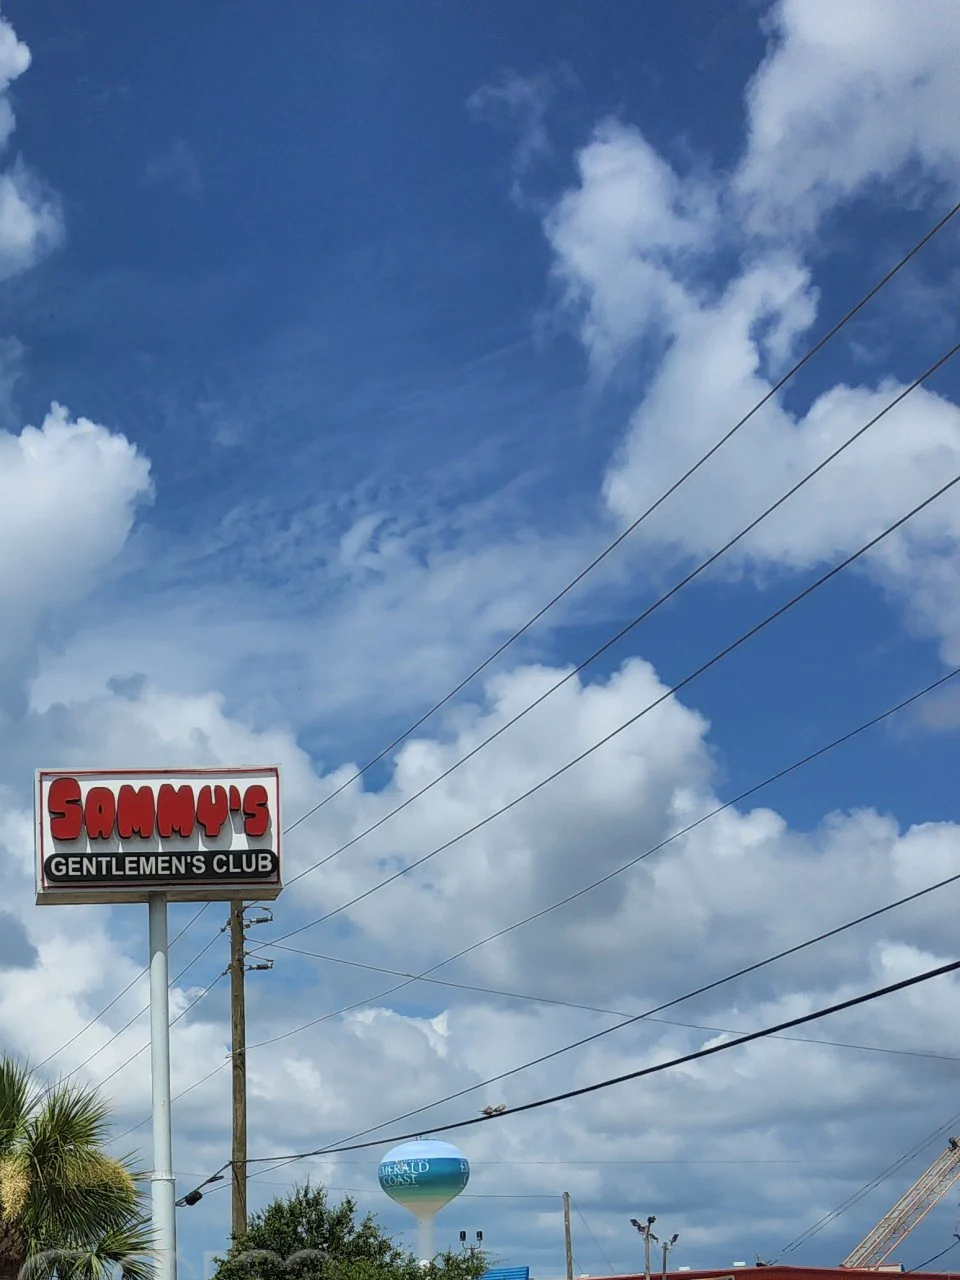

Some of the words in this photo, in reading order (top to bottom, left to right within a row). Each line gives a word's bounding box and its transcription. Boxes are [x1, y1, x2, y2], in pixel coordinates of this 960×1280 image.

[48, 777, 270, 840] SAMMY'S
[50, 854, 206, 877] GENTLEMEN'S
[212, 853, 273, 874] CLUB
[383, 1173, 418, 1187] COAST
